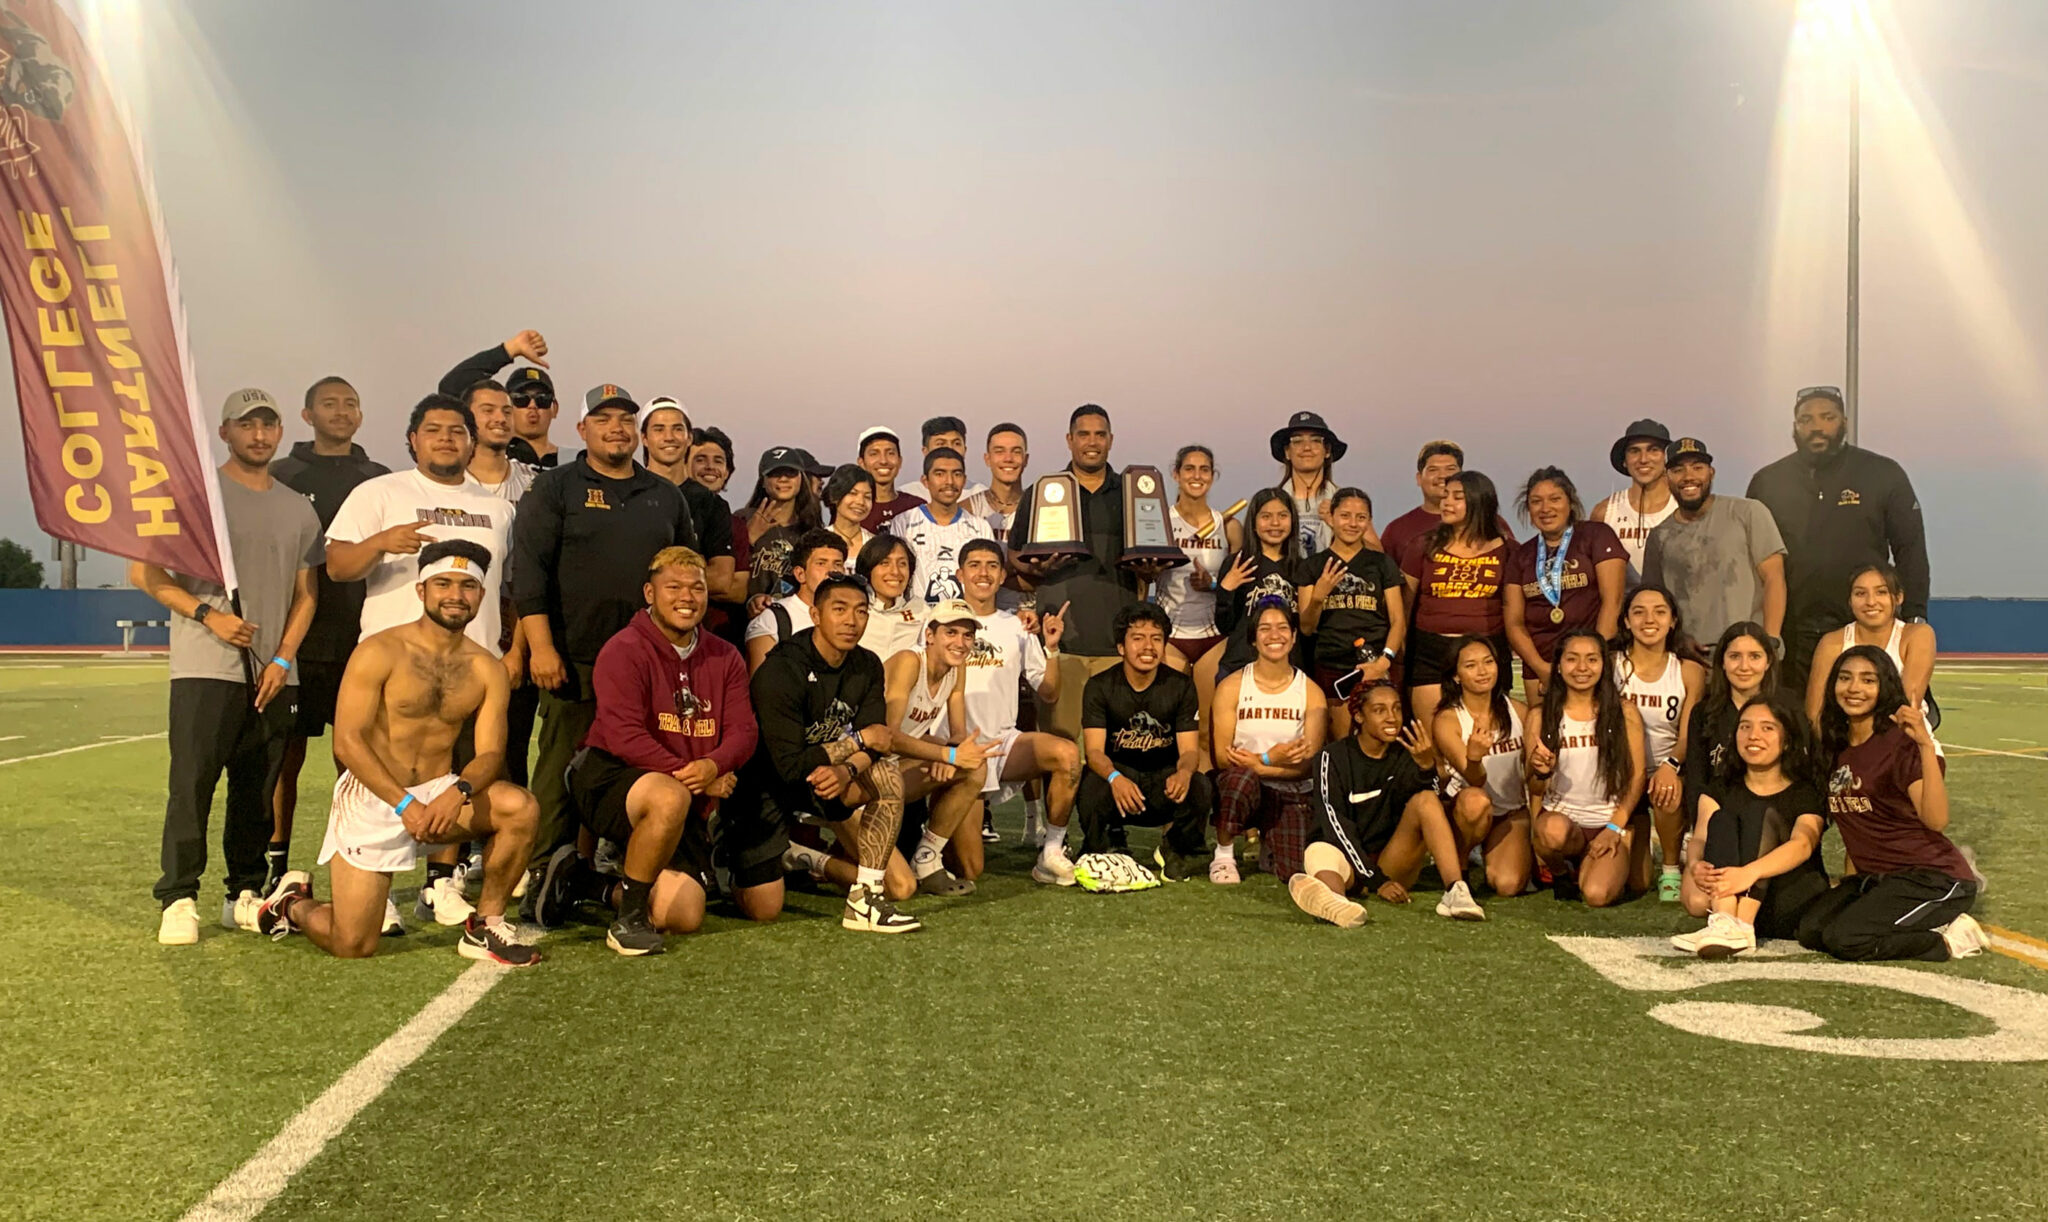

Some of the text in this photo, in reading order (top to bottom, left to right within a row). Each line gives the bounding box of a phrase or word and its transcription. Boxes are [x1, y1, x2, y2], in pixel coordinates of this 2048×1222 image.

[242, 392, 268, 403] USA
[1434, 553, 1500, 566] HARTNELL
[1431, 581, 1472, 592] TRACK
[901, 610, 915, 621] H
[1239, 707, 1302, 721] HARTNELL
[1666, 695, 1679, 721] 8
[682, 718, 691, 736] &
